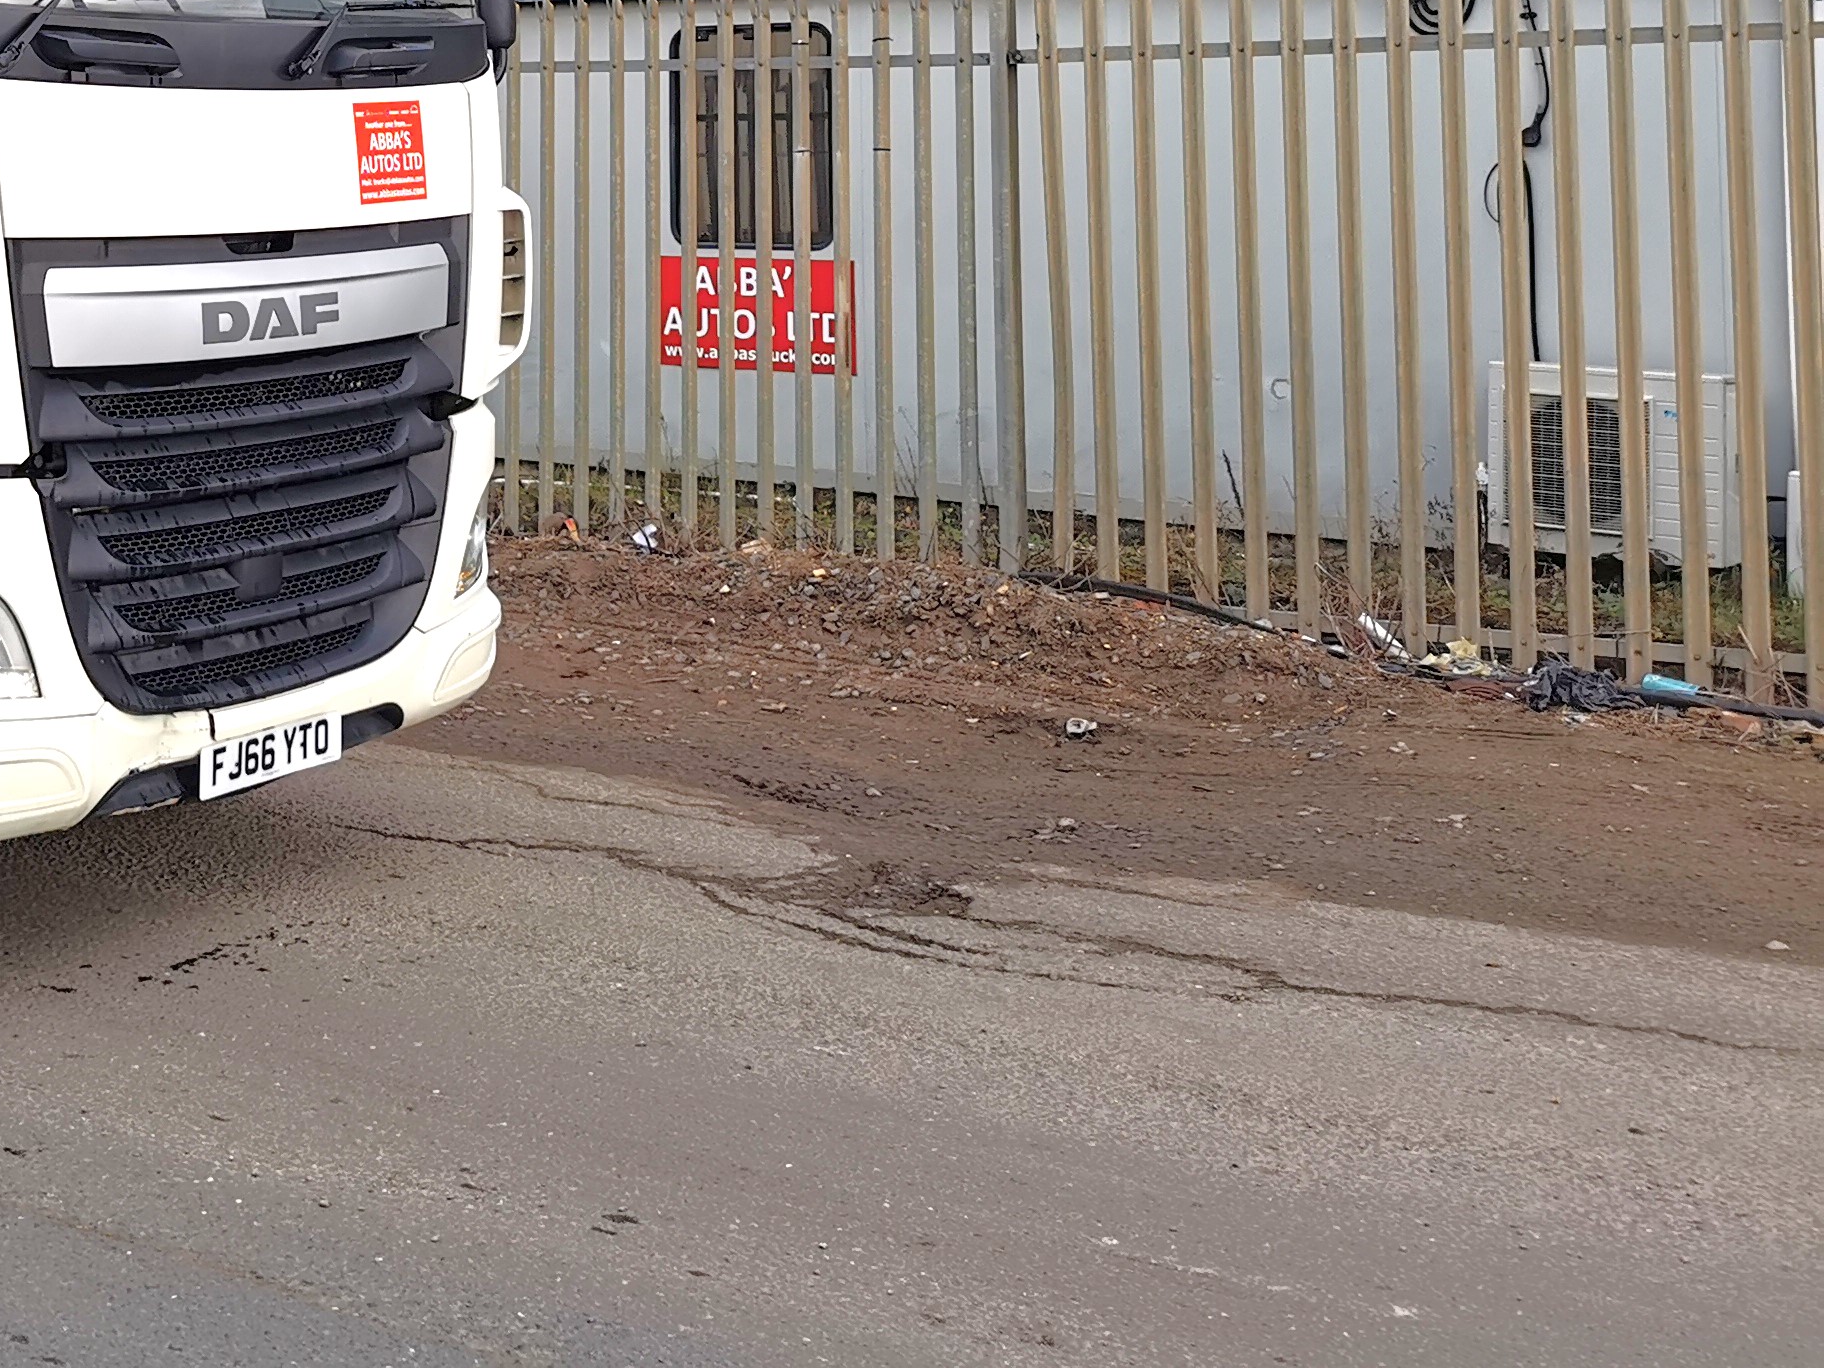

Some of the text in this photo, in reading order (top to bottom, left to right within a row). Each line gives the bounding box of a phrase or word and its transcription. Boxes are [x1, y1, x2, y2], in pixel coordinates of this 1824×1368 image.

[369, 130, 412, 151] ABBA'S
[360, 151, 423, 175] AUTOS LTD
[200, 290, 340, 346] DAF
[211, 718, 329, 787] FJ66 YTO
